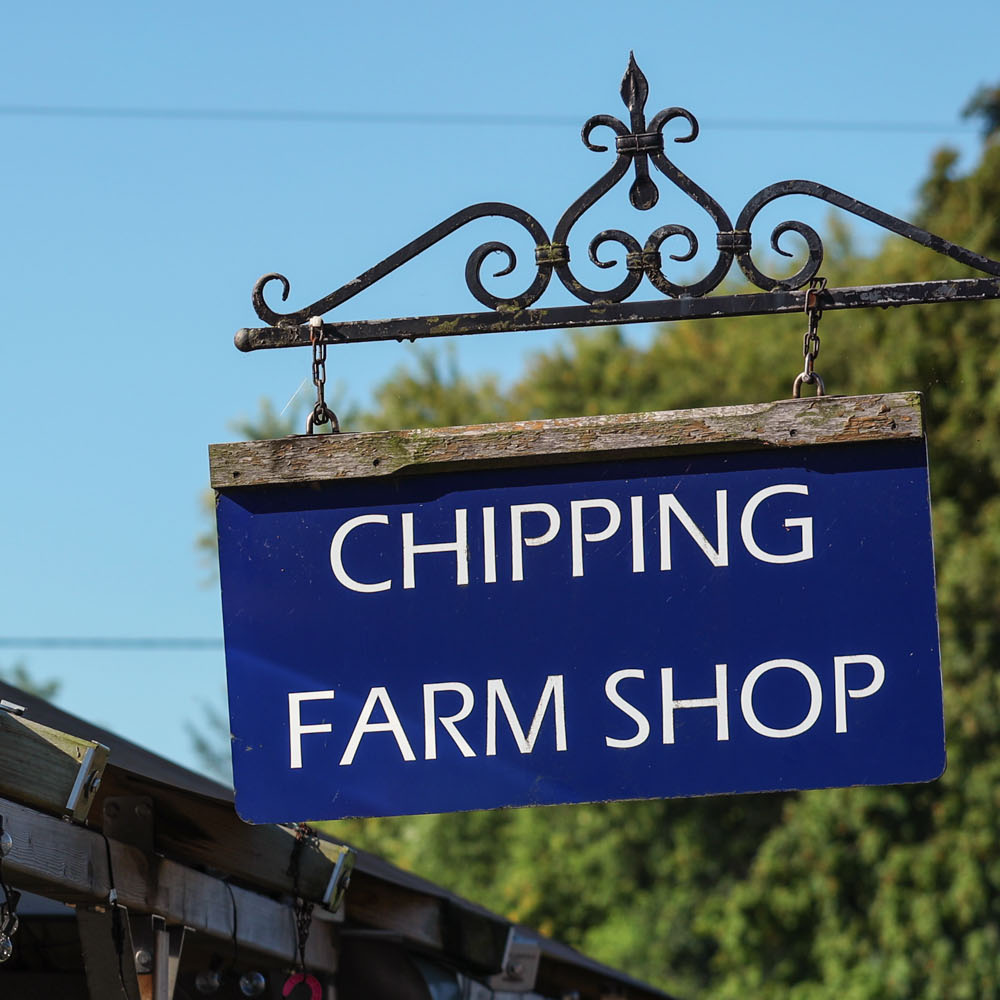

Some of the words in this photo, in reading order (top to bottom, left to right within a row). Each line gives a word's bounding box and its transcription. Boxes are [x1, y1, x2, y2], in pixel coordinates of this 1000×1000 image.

[329, 484, 814, 593] CHIPPING
[288, 674, 568, 769] FARM
[604, 654, 886, 750] SHOP
